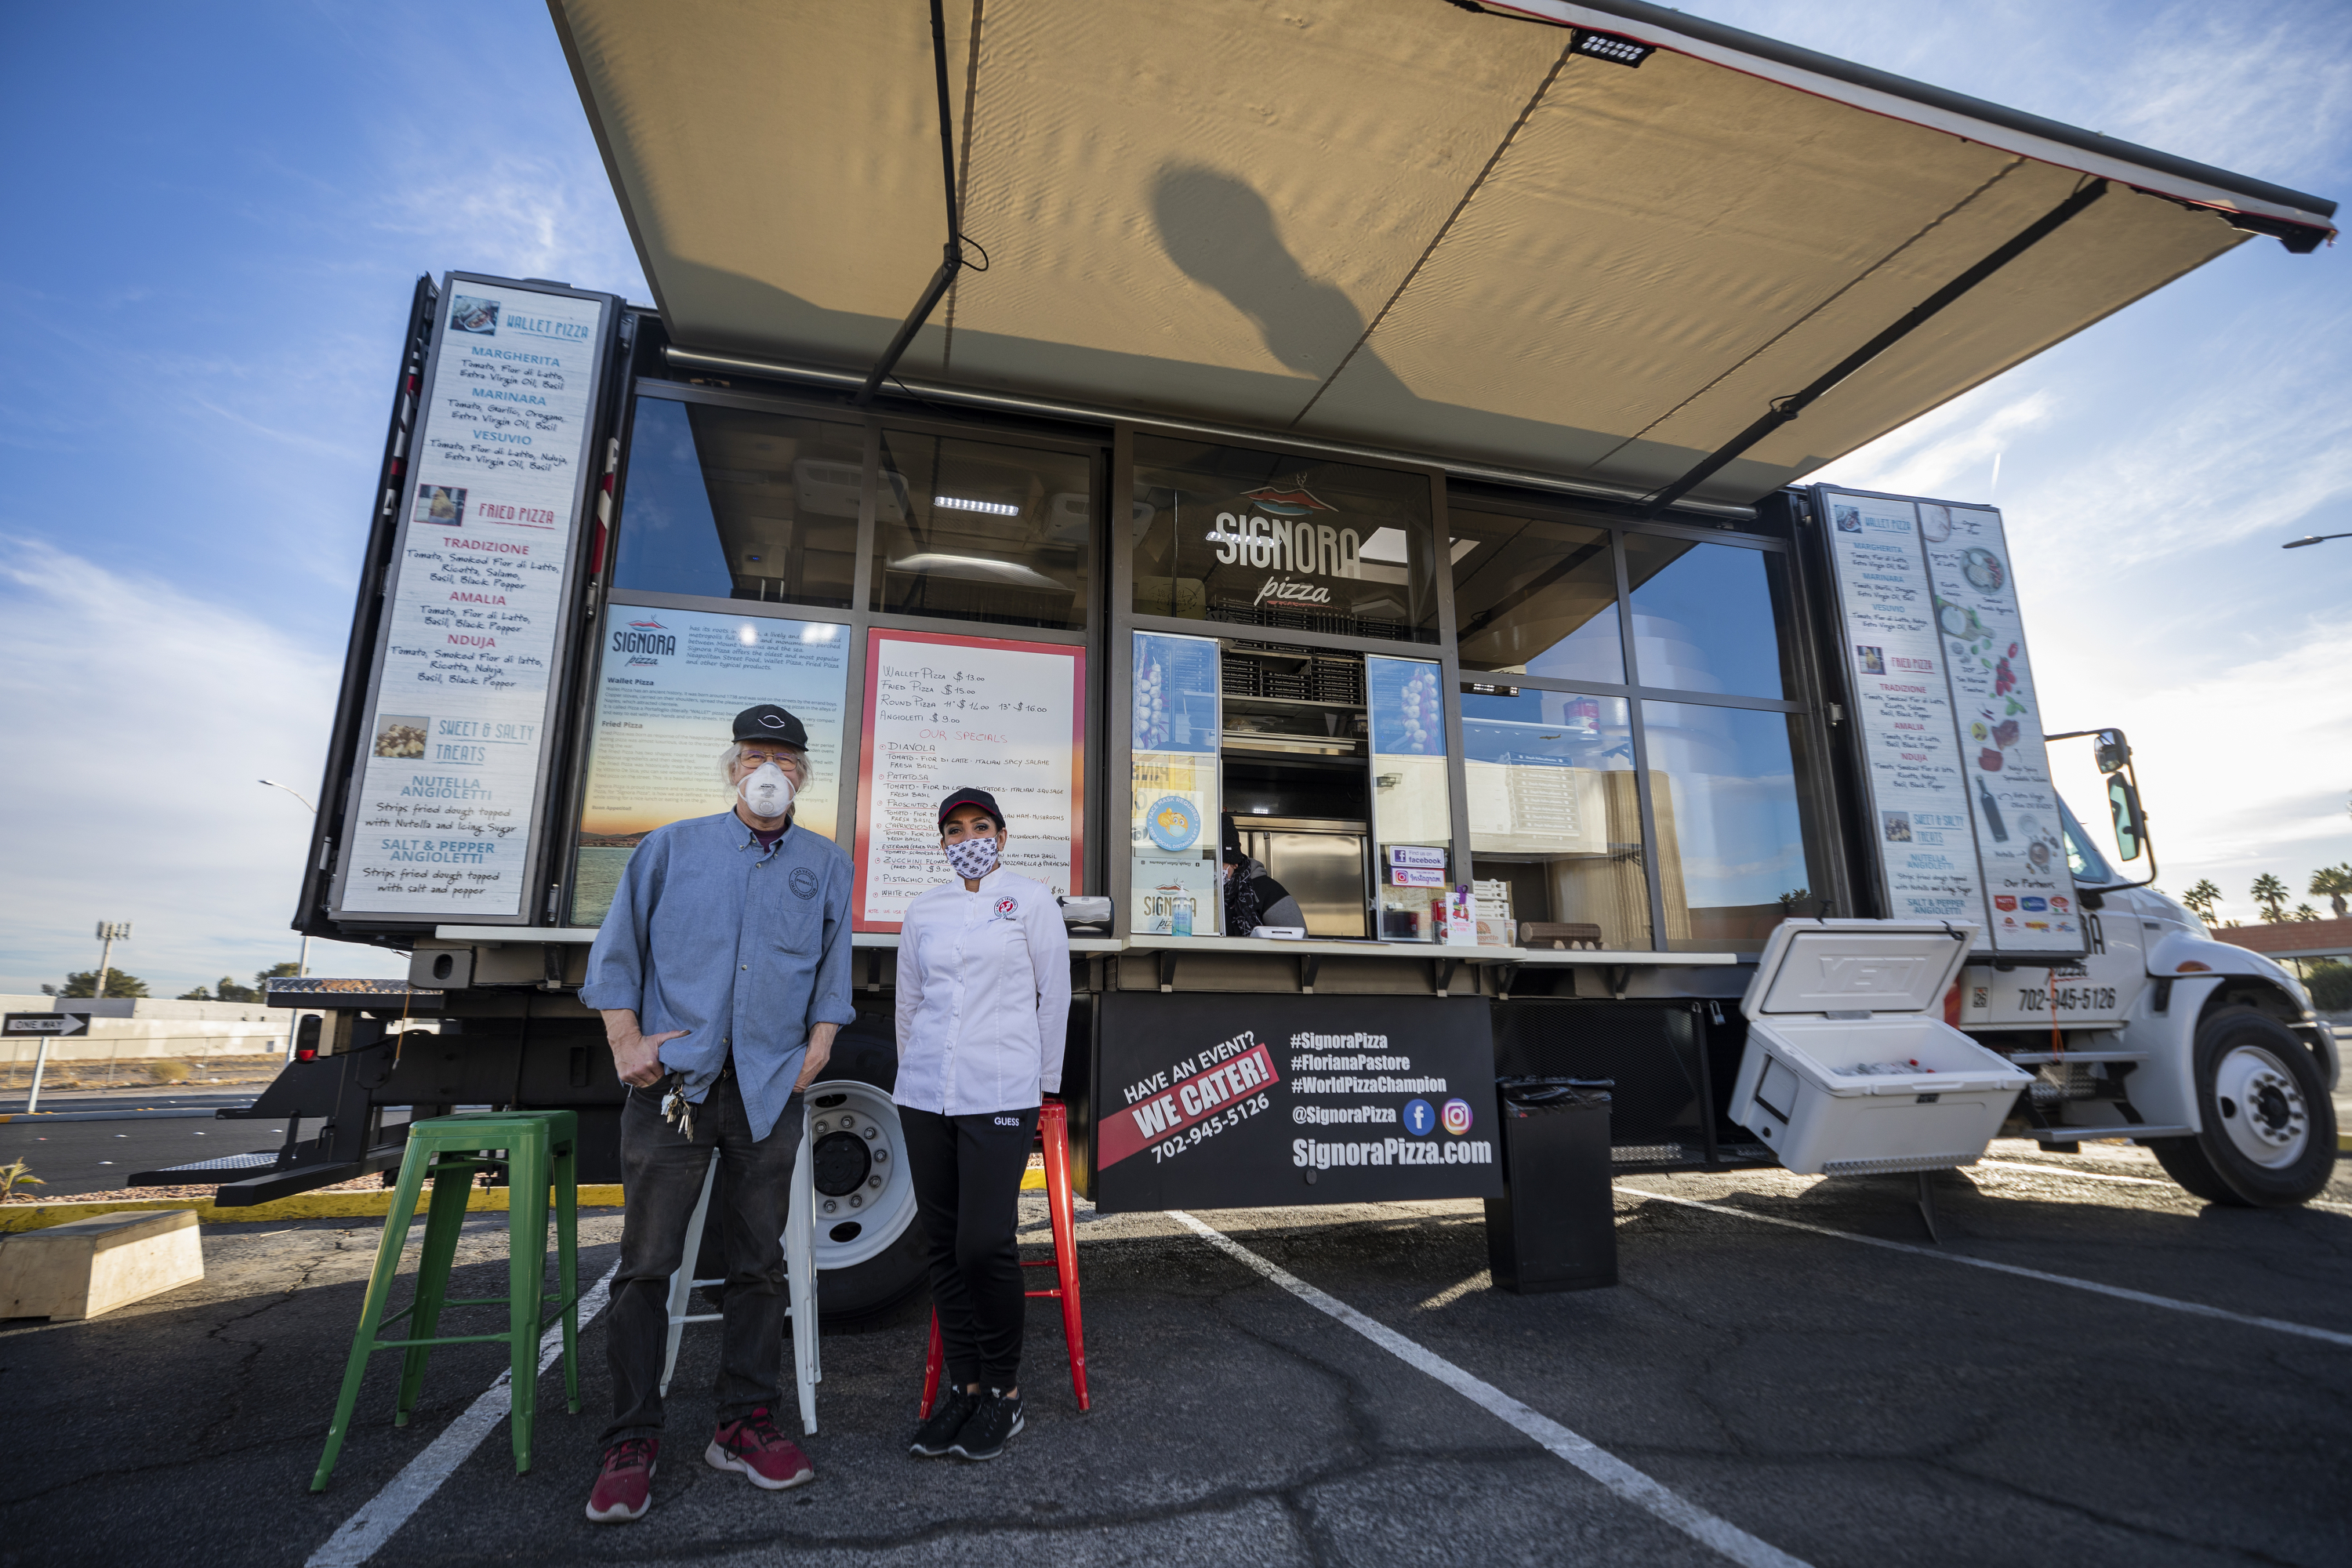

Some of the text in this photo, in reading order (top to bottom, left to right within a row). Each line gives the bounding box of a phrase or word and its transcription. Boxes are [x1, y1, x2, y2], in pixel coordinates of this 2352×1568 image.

[506, 314, 589, 339] WALLET PIZZA
[471, 346, 561, 368] MARGHERITA
[461, 359, 495, 372] Tomato,
[500, 365, 521, 374] Fior
[524, 367, 534, 376] di
[459, 369, 564, 391] Extra Virgin Oil, Basil
[472, 387, 546, 406] MARINARA
[473, 429, 532, 446] VESUVIO
[479, 503, 555, 524] FRIED PIZZA
[1864, 517, 1911, 531] WALLET PIZZA
[442, 536, 530, 555] TRADIZIONE
[1215, 511, 1361, 579] SIGNORA
[1853, 542, 1904, 554] MARGHERITA
[1862, 572, 1904, 583] MARINARA
[1254, 575, 1331, 606] pizza
[448, 591, 507, 606] AMALIA
[1872, 604, 1905, 613] VESUVIO
[447, 633, 496, 648] NDUJA
[612, 631, 676, 655] SIGNORA
[624, 655, 659, 666] pizza
[686, 652, 720, 661] Neapolitan
[1891, 657, 1933, 670] FRIED PIZZA
[1879, 683, 1927, 694] TRADIZIONE
[438, 720, 535, 741] SWEET & SALTY
[1894, 722, 1926, 731] AMALIA
[920, 728, 1007, 743] OUR SPECIALS
[436, 743, 486, 762] TREATS
[887, 742, 935, 752] DIAVOLA
[1900, 753, 1929, 763] NDUJA
[412, 775, 481, 789] NUTELLA
[887, 771, 929, 780] PATATOSA
[400, 786, 492, 800] ANGIOLETTI
[376, 801, 511, 820] Strips fried dough topped
[1148, 797, 1200, 822] FACE MASK REQUIRED
[365, 817, 517, 837] with Nutella and Icing Sugar
[1914, 814, 1935, 826] SWEET
[1944, 815, 1964, 827] SALTY
[1156, 837, 1172, 849] SOCIAL
[1173, 838, 1193, 848] DISTANCE
[1918, 831, 1944, 843] TREATS
[381, 839, 495, 855] SALT & PEPPER
[389, 850, 483, 864] ANGIOLETTI
[1409, 856, 1442, 865] facebook
[1910, 854, 1947, 862] NUTELLA
[1907, 862, 1955, 870] ANGIOLETTI
[883, 874, 924, 883] PISTACHIO
[1410, 873, 1442, 884] Instagram
[1144, 896, 1197, 917] SIGNA
[1817, 957, 1927, 993] YETI
[1290, 1031, 1388, 1052] #SignoraPizza
[1123, 1029, 1256, 1105] HAVE AN EVENT?
[1290, 1054, 1410, 1072] #FlorianaPastore
[1291, 1075, 1447, 1096] #WorldPizzaChampion
[1131, 1051, 1271, 1139] WE CATER!
[994, 1116, 1019, 1127] GUESS
[1292, 1105, 1397, 1126] @SignoraPizza
[1151, 1091, 1271, 1164] 702-945-5126
[1292, 1137, 1493, 1171] SignoraPizza.com
